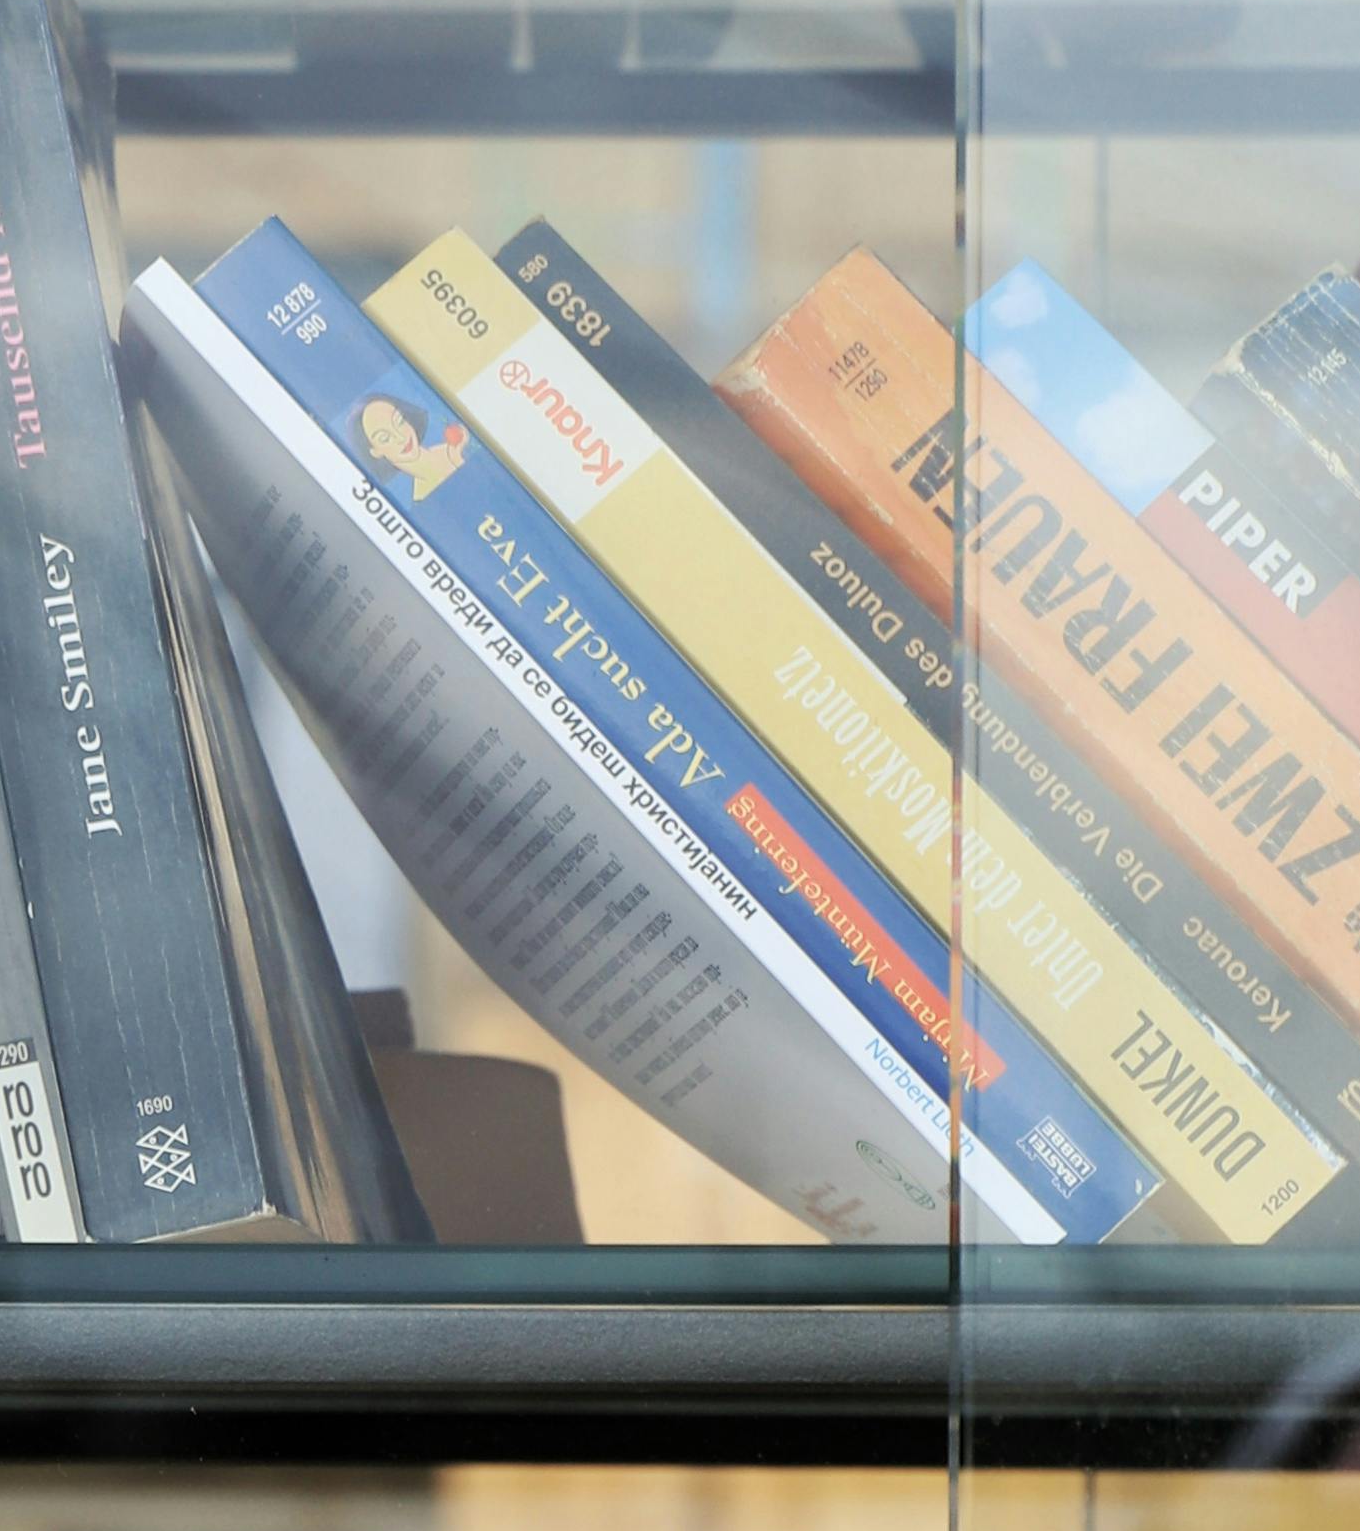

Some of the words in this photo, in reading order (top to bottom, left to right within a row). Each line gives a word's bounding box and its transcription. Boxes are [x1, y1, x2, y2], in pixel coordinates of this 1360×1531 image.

[421, 268, 490, 341] 60395
[546, 281, 611, 349] 1839
[523, 378, 625, 487] Knaur
[476, 514, 551, 606] Eva
[811, 541, 905, 643] Duluoz
[1178, 469, 1319, 614] PIPER
[40, 534, 95, 712] Smiley
[351, 479, 424, 562] Зошто
[424, 560, 496, 636] вреди
[485, 626, 526, 670] да
[523, 662, 554, 699] се
[551, 688, 626, 777] бидеш
[546, 591, 647, 700] sucht
[905, 641, 950, 689] des
[77, 727, 122, 838] Jane
[644, 702, 726, 791] Ada
[962, 683, 1112, 856] Verblendung
[1115, 845, 1164, 907] Die
[1183, 916, 1292, 1033] Kerouac
[136, 1095, 173, 1117] 1690
